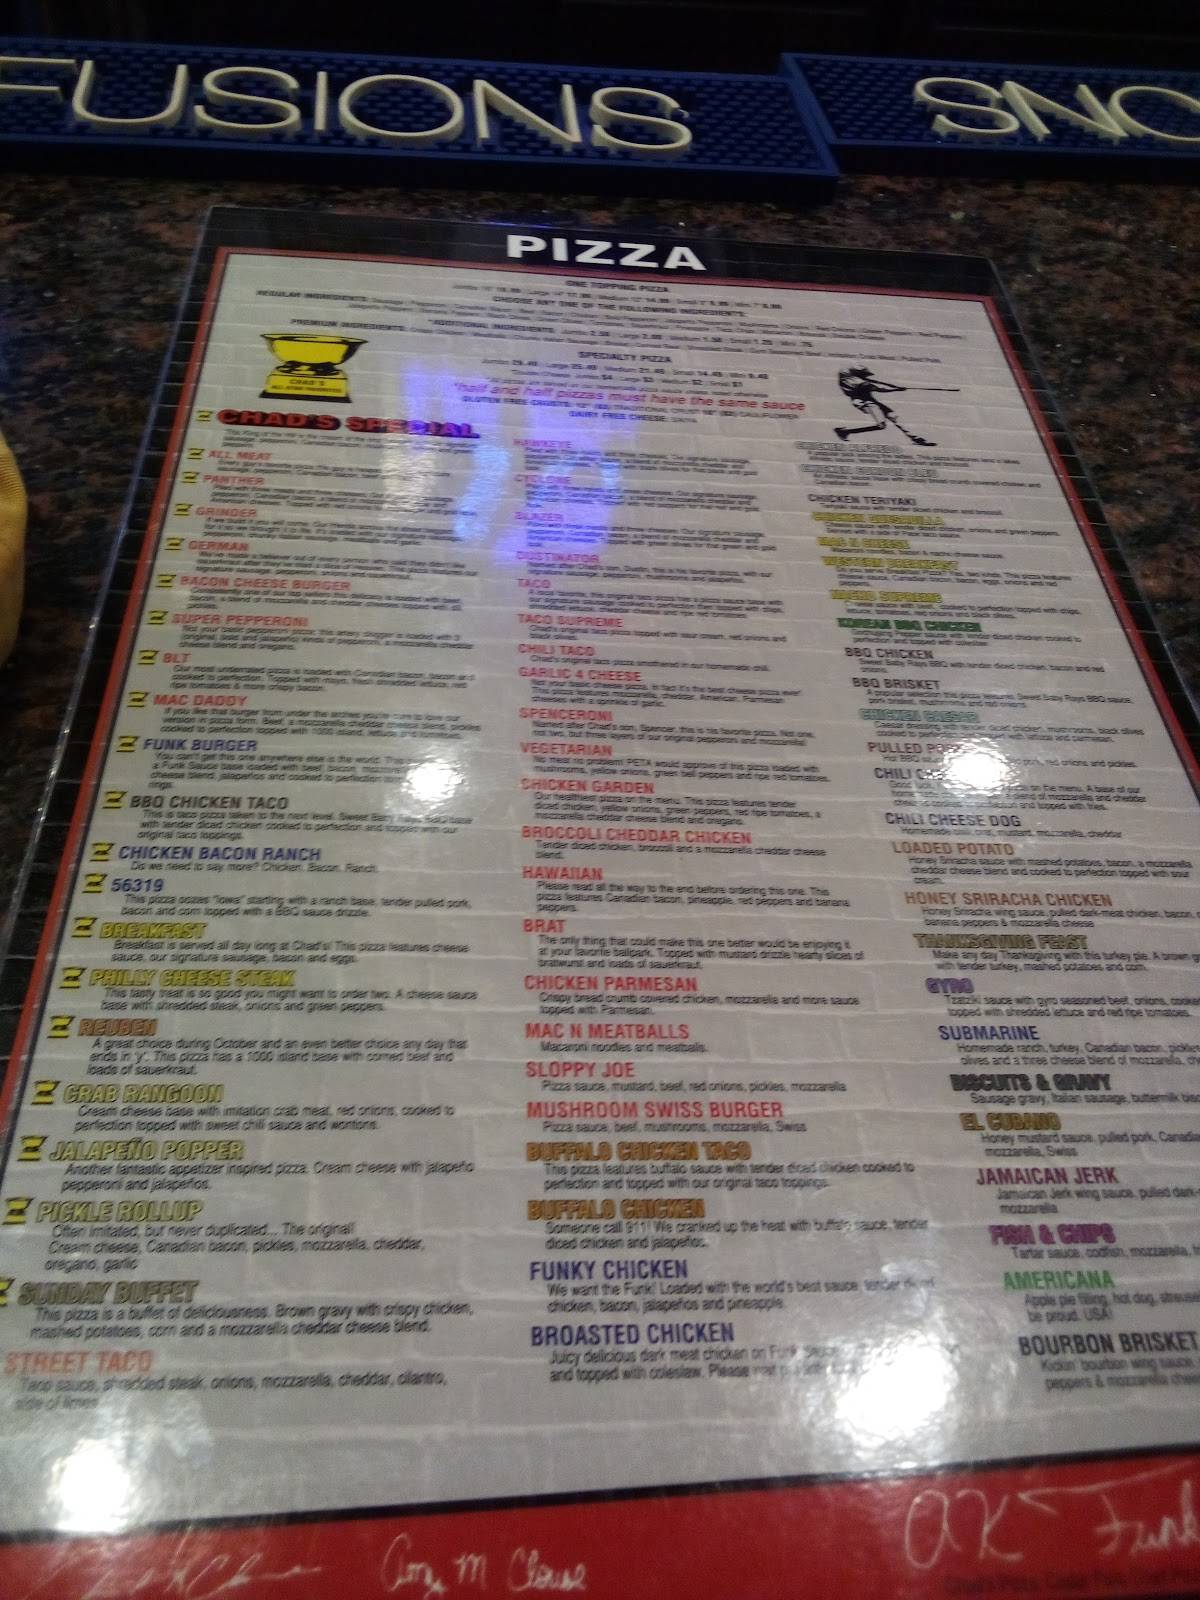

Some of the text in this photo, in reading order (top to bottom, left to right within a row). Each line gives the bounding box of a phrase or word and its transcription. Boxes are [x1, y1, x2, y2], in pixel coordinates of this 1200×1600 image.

[506, 233, 707, 272] PIZZA
[640, 355, 672, 363] PIZZA
[651, 394, 686, 404] have
[690, 396, 713, 405] the
[718, 399, 758, 408] same
[762, 401, 806, 410] sauce
[216, 408, 341, 430] CHAD'S
[345, 416, 481, 439] SPECIAL
[203, 474, 264, 485] PANTHER
[808, 493, 860, 503] CHICKEN
[196, 506, 256, 518] GRINDER
[188, 540, 249, 551] GERMAN
[180, 575, 350, 591] BACON CHEESE BURGER
[518, 578, 551, 588] TACO
[171, 613, 221, 624] SUPER
[518, 613, 623, 628] TACO SUPREME
[518, 643, 596, 656] CHILI TACO
[845, 647, 933, 660] BBQ CHICKEN
[163, 652, 190, 663] BLT
[518, 667, 571, 679] GARLIC
[588, 669, 641, 682] CHEESE
[852, 678, 941, 690] BBQ BRISKET
[153, 694, 247, 707] MAC DADDY
[143, 739, 257, 752] FUNK BURGER
[520, 742, 612, 756] VEGETARIAN
[868, 742, 922, 754] PULLED
[874, 768, 912, 779] CHILI
[521, 778, 655, 793] CHICKEN GARDEN
[130, 796, 288, 810] BBQ CHICKEN TACO
[885, 812, 1022, 827] CHILI CHEESE DOG
[521, 826, 752, 844] BROCCOLI CHEDDAR CHICKEN
[118, 847, 323, 862] CHICKEN BACON RANCH
[892, 842, 1014, 856] LOADED POTATO
[522, 866, 602, 881] HAWAIIAN
[110, 878, 164, 892] 56319
[905, 892, 1112, 907] HONEY SRIRACHA CHICKEN
[99, 921, 206, 939] BREAKFAST
[523, 919, 566, 932] BRAT
[90, 968, 156, 987] PHILLY
[159, 968, 232, 987] CHEESE
[524, 976, 698, 992] CHICKEN PARMESAN
[525, 1022, 689, 1040] MAC N MEATBALLS
[938, 1025, 1040, 1040] SUBMARINE
[526, 1062, 635, 1079] SLOPPY JOE
[62, 1083, 224, 1104] CRAB RANGOON
[527, 1101, 784, 1118] MUSHROOM SWISS BURGER
[960, 1113, 984, 1131] EL
[160, 1140, 245, 1160] POPPER
[526, 1140, 752, 1161] BUFFALO CHICKEN TACO
[977, 1167, 1119, 1185] JAMAICAN JERK
[36, 1201, 203, 1222] PICKLE ROLLUP
[528, 1198, 706, 1220] BUFFALO CHICKEN
[530, 1259, 688, 1280] FUNKY CHICKEN
[1004, 1270, 1115, 1291] AMERICANA
[18, 1282, 112, 1305] SUNDAY
[34, 1308, 62, 1322] This
[63, 1308, 98, 1324] pizza
[128, 1305, 164, 1321] buffet
[275, 1304, 316, 1319] Brown
[318, 1305, 357, 1321] gravy
[359, 1304, 380, 1318] with
[383, 1304, 421, 1320] crispy
[531, 1323, 734, 1347] BROASTED CHICKEN
[1017, 1331, 1198, 1356] BOURBON BRISKET
[5, 1352, 152, 1375] STREET TACO
